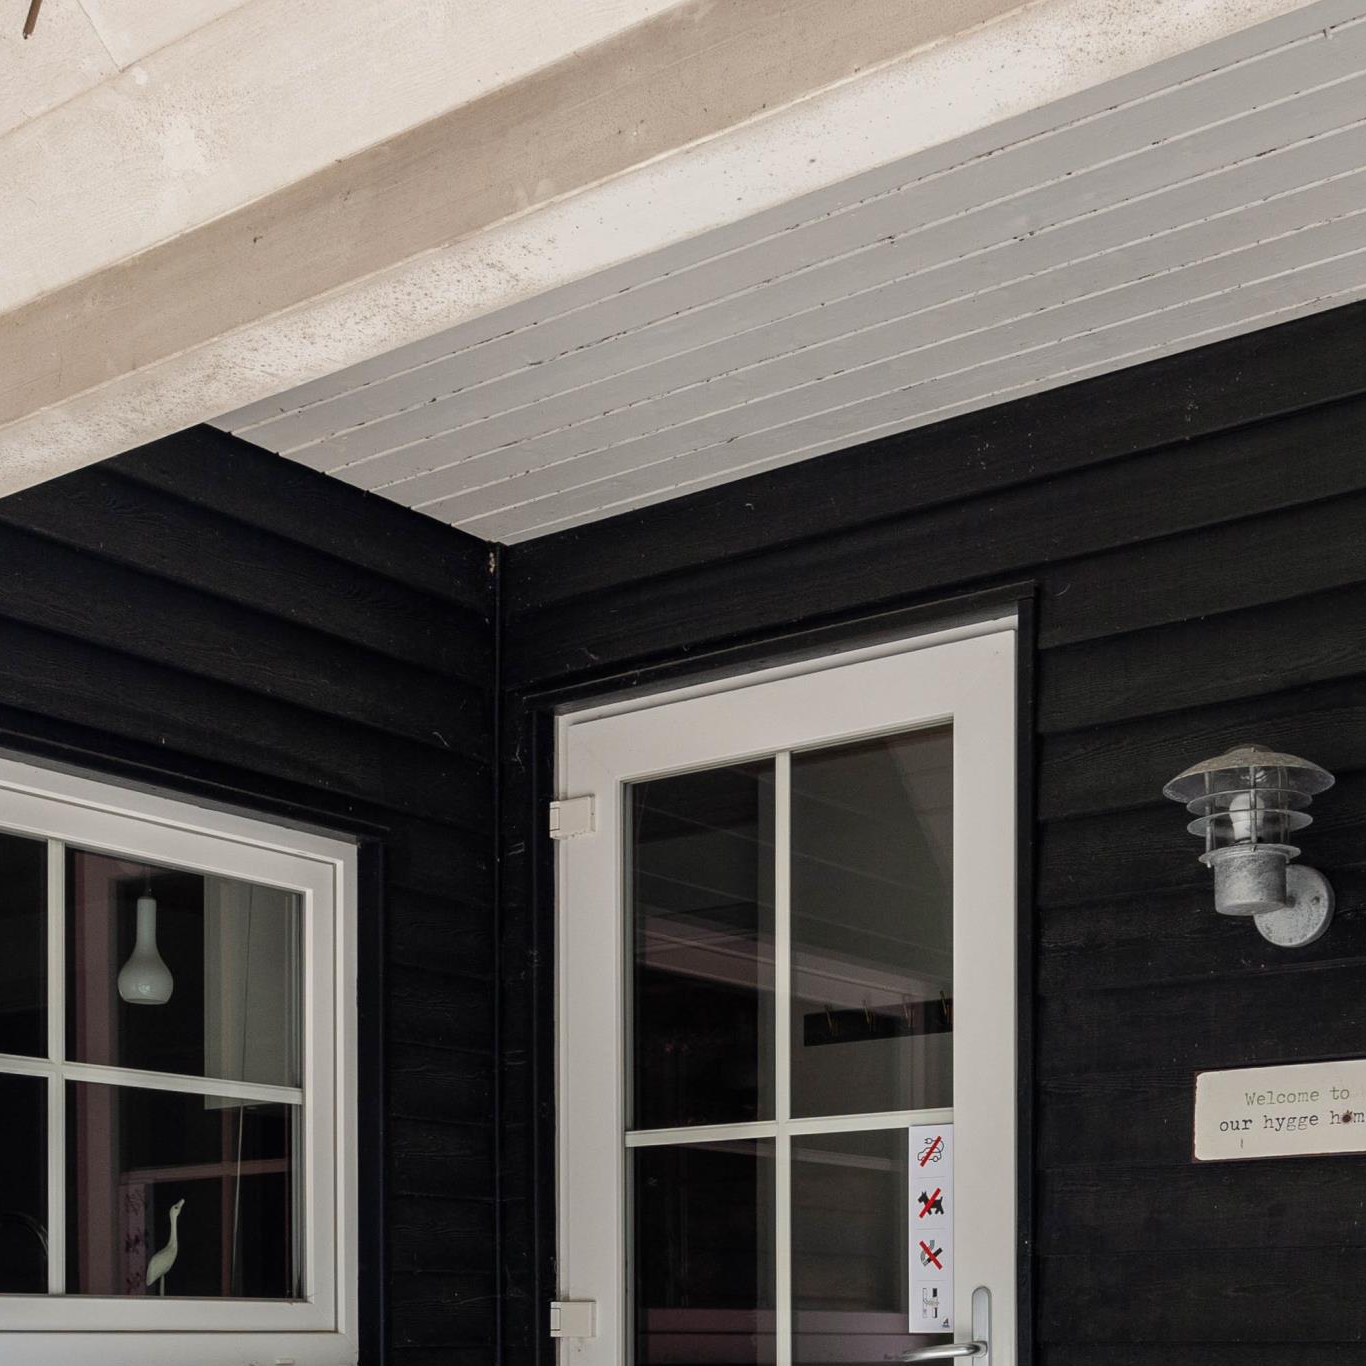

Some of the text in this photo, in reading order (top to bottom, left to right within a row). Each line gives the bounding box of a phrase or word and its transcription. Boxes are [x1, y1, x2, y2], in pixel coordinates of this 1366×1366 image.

[1244, 1086, 1350, 1106] Welcome to
[1219, 1118, 1253, 1132] our
[1263, 1114, 1319, 1131] hygge
